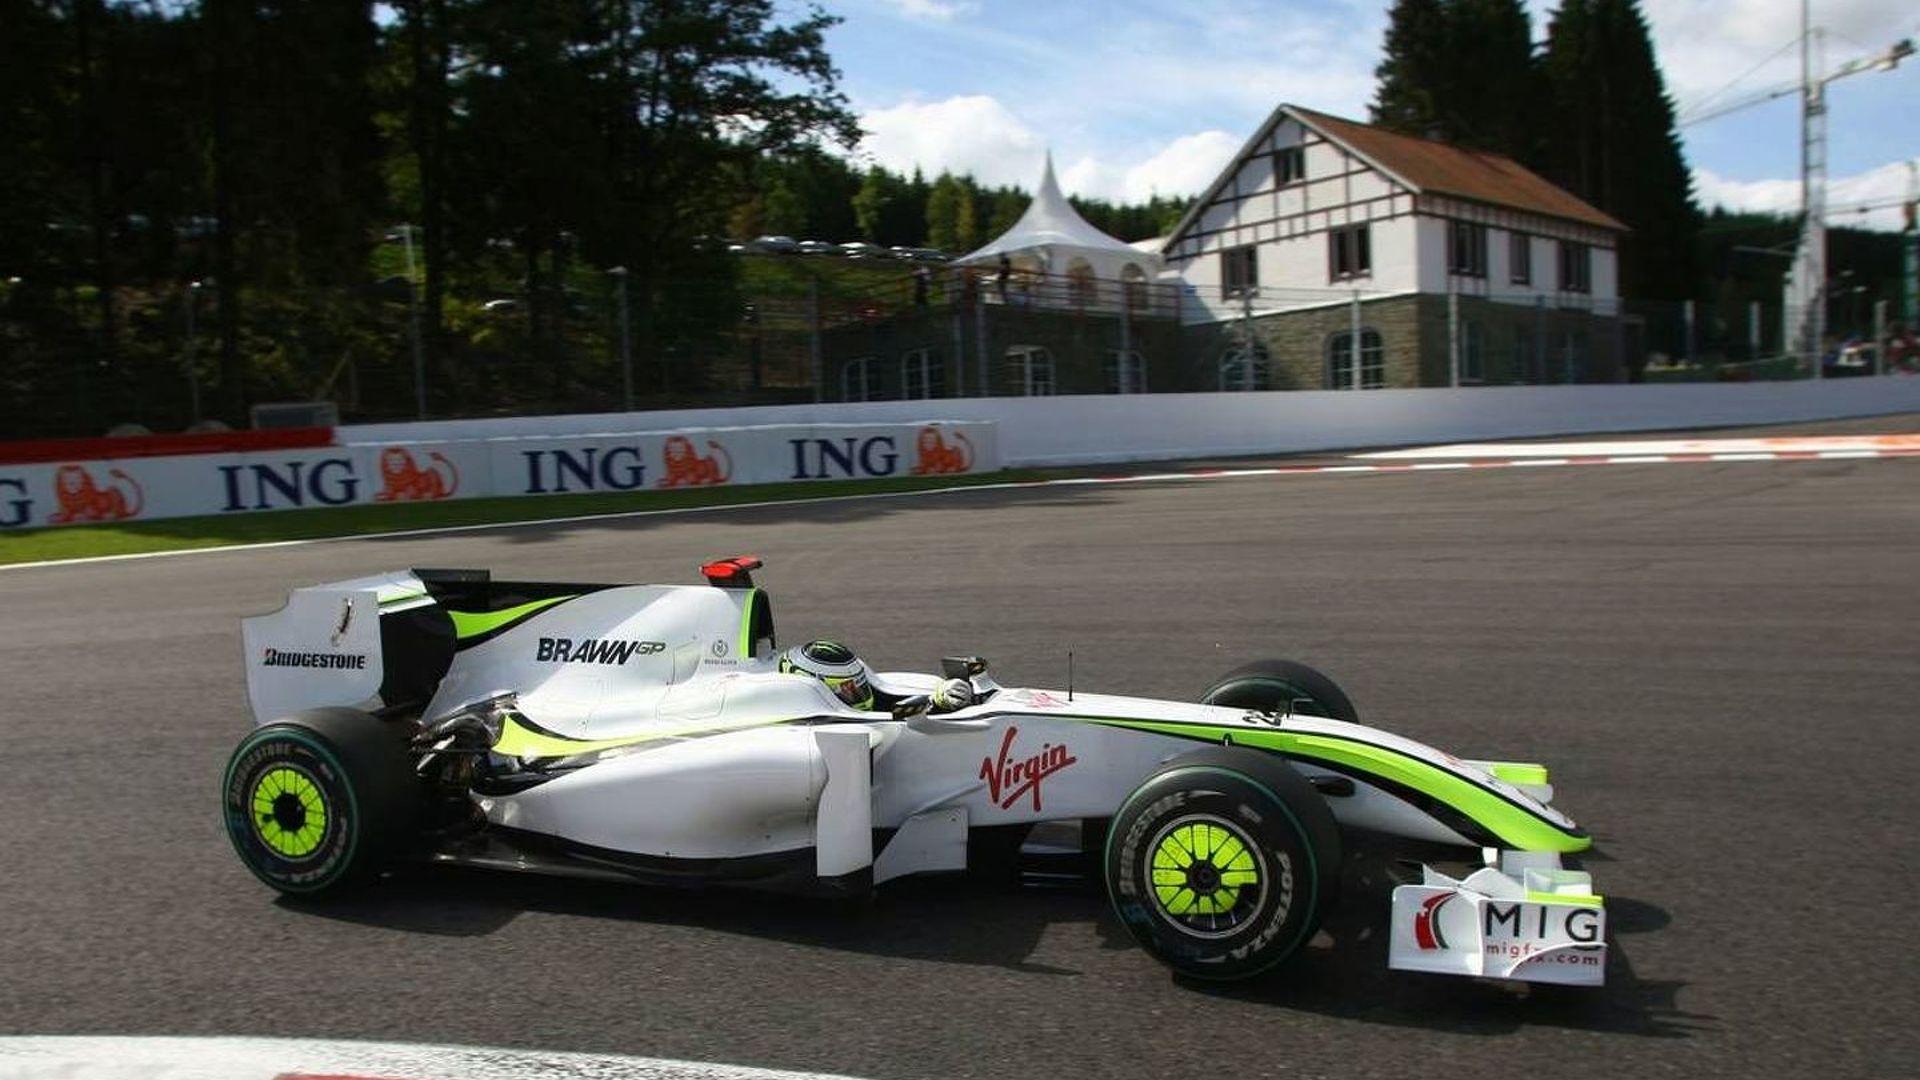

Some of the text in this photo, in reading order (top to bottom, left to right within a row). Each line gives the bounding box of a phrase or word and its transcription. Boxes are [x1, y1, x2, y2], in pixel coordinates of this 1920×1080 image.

[523, 446, 646, 493] ING
[790, 437, 898, 479] ING
[218, 459, 359, 511] ING
[264, 648, 365, 670] BRIDGESTONE
[536, 637, 638, 665] BRAWN
[979, 726, 1077, 812] Virgin
[1485, 902, 1599, 949] MIG
